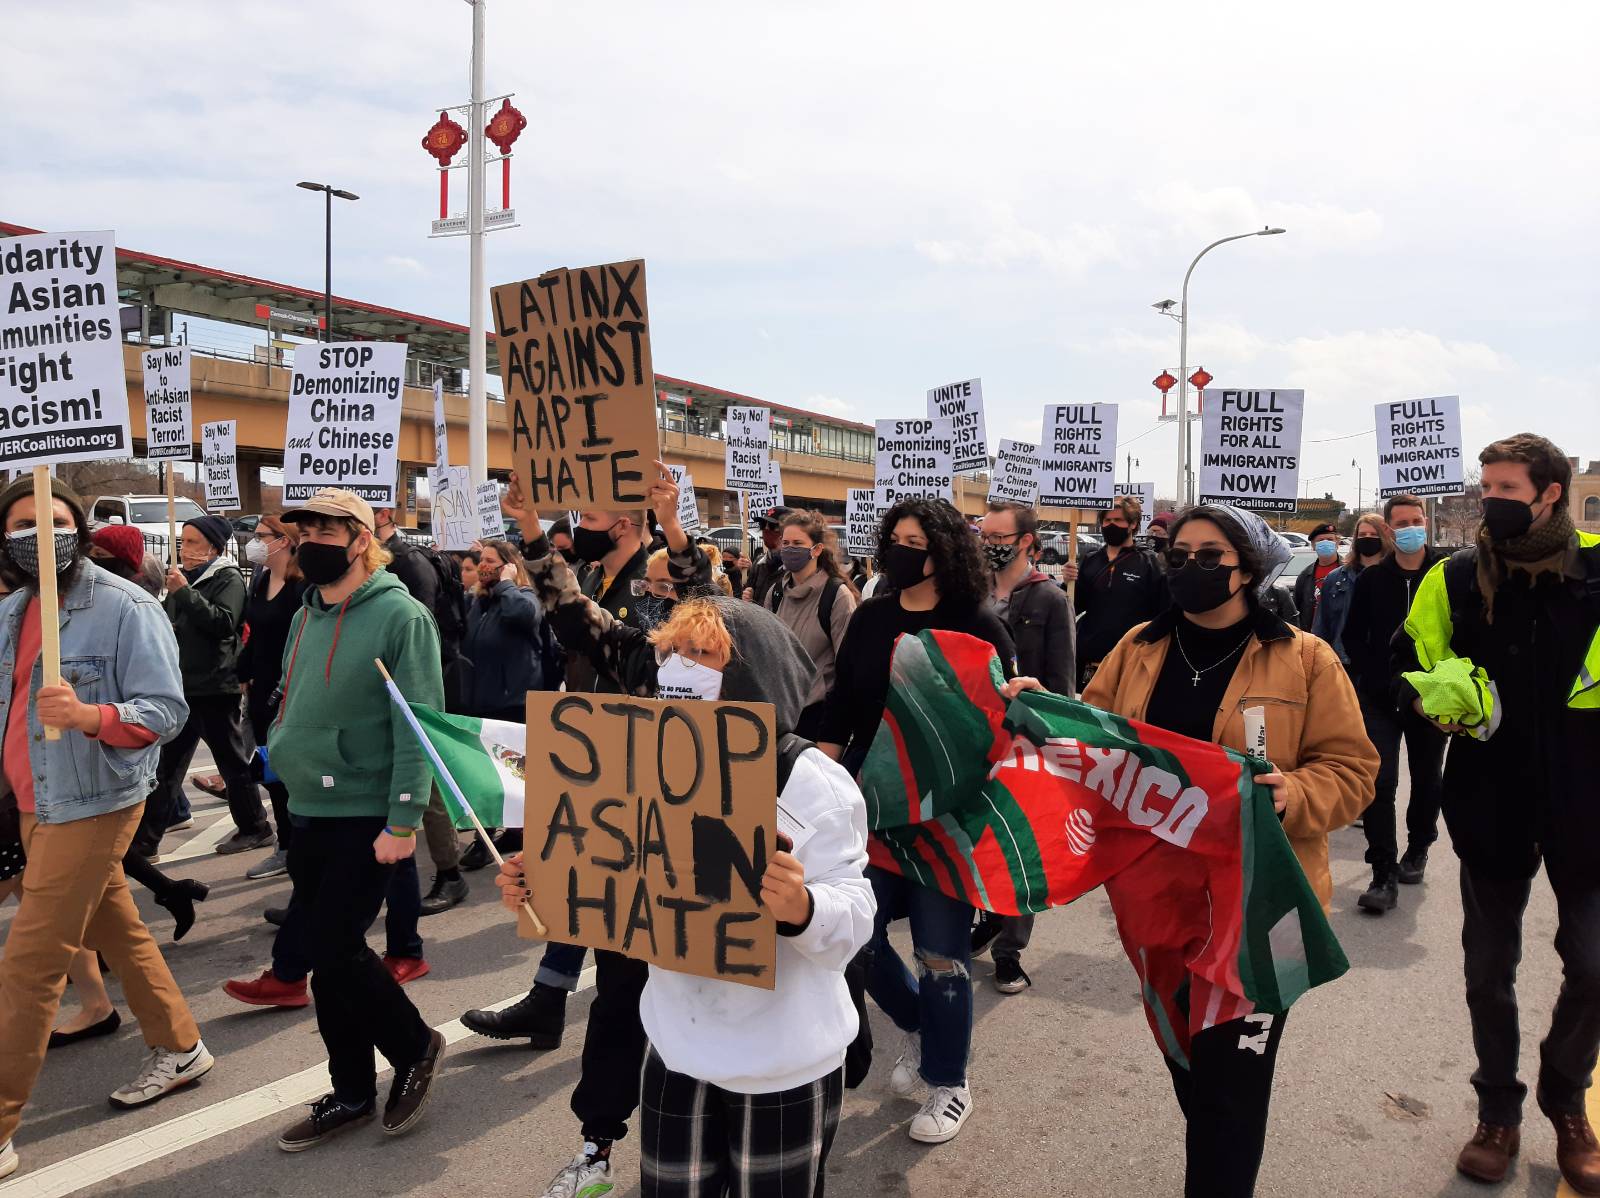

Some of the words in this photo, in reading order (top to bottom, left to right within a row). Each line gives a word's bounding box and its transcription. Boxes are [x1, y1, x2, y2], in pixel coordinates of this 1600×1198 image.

[8, 277, 105, 314] Asian
[494, 263, 644, 338] LATINX
[147, 354, 162, 372] Say
[165, 351, 182, 367] No!
[319, 346, 373, 369] STOP
[507, 320, 646, 396] AGAINST
[159, 374, 168, 386] to
[293, 371, 399, 400] Demonizing
[146, 387, 189, 406] Anti-Asian
[934, 382, 971, 403] UNITE
[939, 400, 966, 417] NOW
[1221, 391, 1284, 412] FULL
[151, 407, 183, 425] Racist
[310, 398, 375, 423] China
[732, 409, 746, 424] Say
[749, 409, 763, 422] No!
[1055, 406, 1102, 424] FULL
[1390, 400, 1443, 421] FULL
[512, 393, 614, 452] AAPI
[743, 426, 751, 435] to
[895, 421, 933, 435] STOP
[1221, 416, 1283, 432] RIGHTS
[1391, 419, 1445, 436] RIGHTS
[152, 425, 185, 444] Terror!
[205, 425, 216, 440] Say
[217, 423, 230, 436] No!
[288, 431, 313, 449] and
[318, 426, 394, 449] Chinese
[1054, 427, 1102, 441] RIGHTS
[213, 442, 220, 451] to
[727, 435, 768, 450] Anti-Asian
[877, 436, 951, 455] Demonizing
[1011, 442, 1035, 452] STOP
[1054, 443, 1075, 454] FOR
[1078, 443, 1100, 455] ALL
[1220, 434, 1248, 447] FOR
[1252, 435, 1281, 448] ALL
[1392, 437, 1417, 449] FOR
[1420, 434, 1445, 446] ALL
[732, 451, 761, 465] Racist
[953, 442, 986, 460] ENCE
[1380, 447, 1459, 465] IMMIGRANTS
[204, 453, 235, 467] Anti-Asian
[299, 453, 379, 481] People!
[891, 454, 936, 469] China
[1042, 459, 1112, 473] IMMIGRANTS
[1203, 453, 1296, 469] IMMIGRANTS
[208, 468, 231, 481] Racist
[530, 450, 647, 504] HATE
[731, 465, 762, 479] Terror!
[1005, 462, 1033, 476] China
[1396, 464, 1445, 483] NOW!
[877, 475, 895, 487] and
[898, 472, 950, 487] Chinese
[1007, 475, 1038, 488] Chinese
[1054, 477, 1097, 493] NOW!
[1220, 473, 1276, 494] NOW!
[208, 482, 232, 497] Terror!
[997, 484, 1031, 498] People!
[1114, 484, 1145, 495] FULL
[1382, 484, 1462, 497] AnswerCoalition.org
[1041, 497, 1112, 508] AnswerCoalition.org
[1201, 497, 1294, 510] AnswerCoalition.org
[549, 695, 769, 817] STOP
[540, 791, 767, 907] ASIAN
[566, 865, 768, 977] HATE
